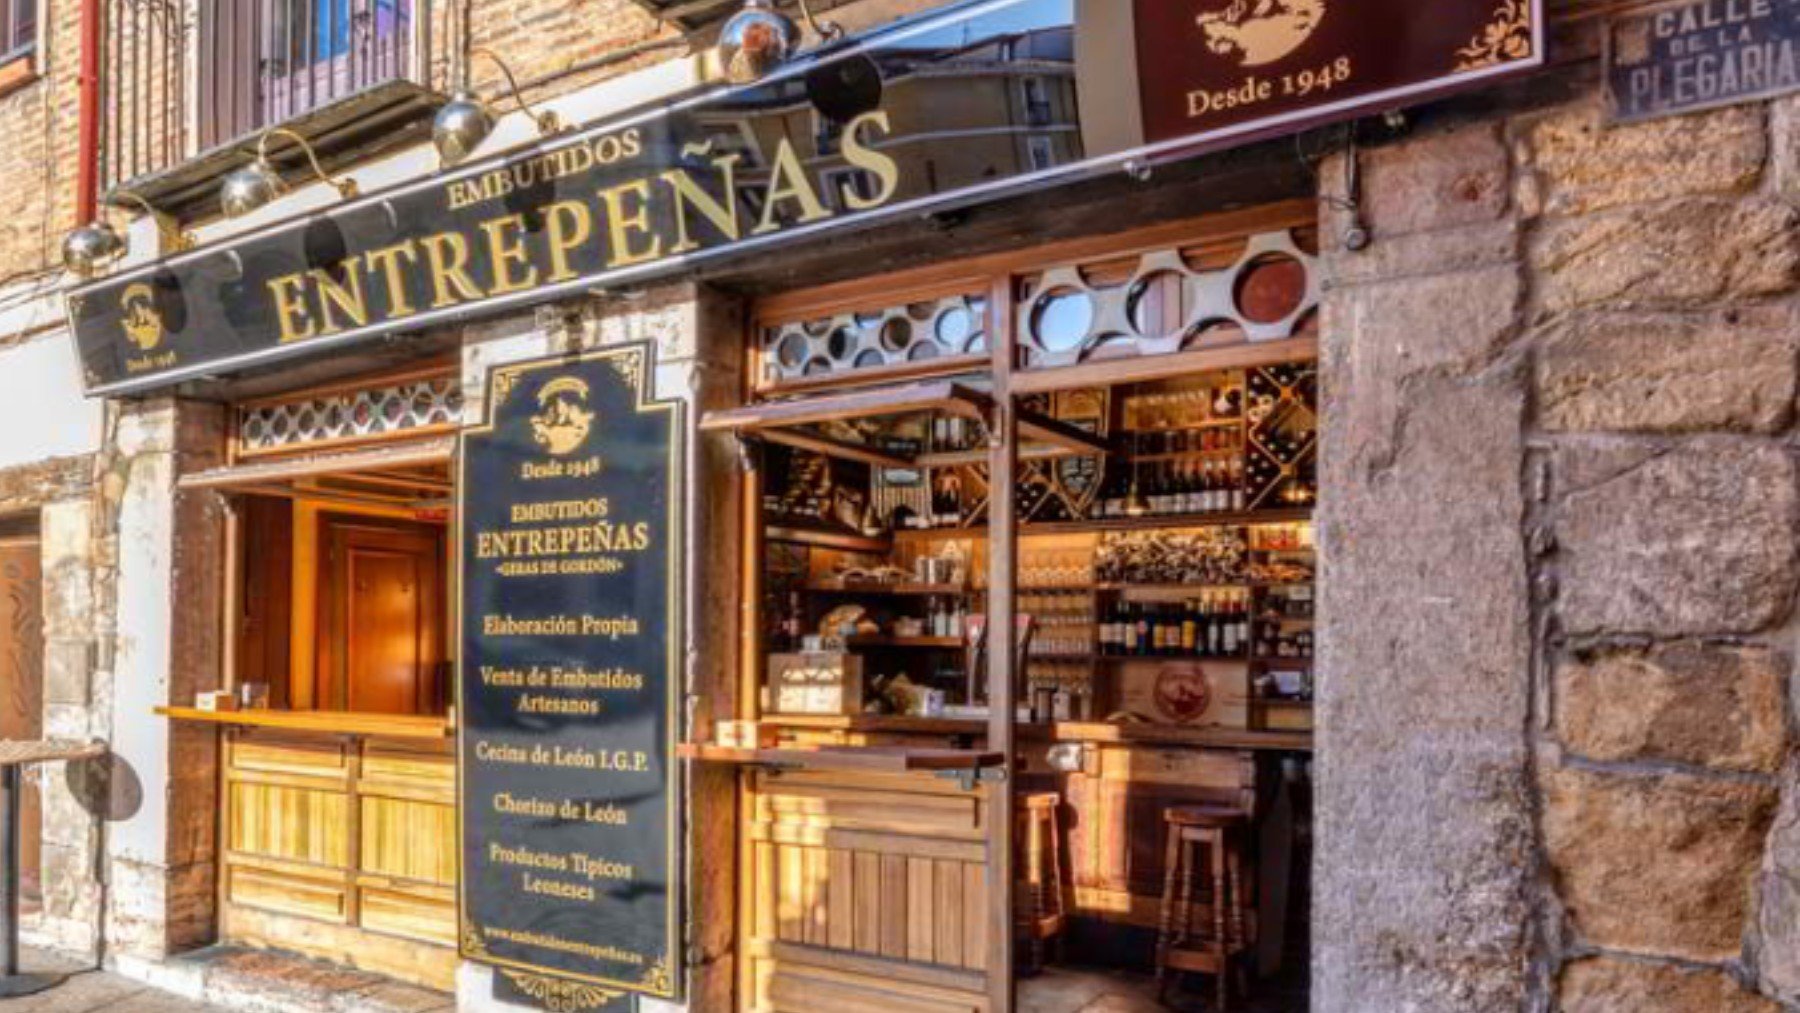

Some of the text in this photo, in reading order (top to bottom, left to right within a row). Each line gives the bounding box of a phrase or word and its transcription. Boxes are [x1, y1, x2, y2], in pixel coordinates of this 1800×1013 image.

[1655, 0, 1772, 38] CALLE
[1669, 24, 1753, 56] DE LA
[1186, 55, 1351, 118] Desde 1948
[1630, 38, 1797, 114] PLEGARIA
[447, 127, 642, 210] EMBUTIDOS
[265, 110, 899, 344] ENTREPEÑAS
[521, 456, 600, 480] Desde 1948
[511, 498, 608, 523] EMBUTIDOS
[476, 521, 649, 558] ENTREPEÑAS
[483, 613, 638, 640] Elaboración Propia
[480, 666, 643, 690] Venta de Embutidos
[518, 693, 599, 715] Artesanos
[476, 741, 649, 772] Cecina de León I.G.P.
[493, 792, 627, 825] Chorizo de León
[489, 842, 566, 870] Productos
[524, 872, 595, 900] Leoneses
